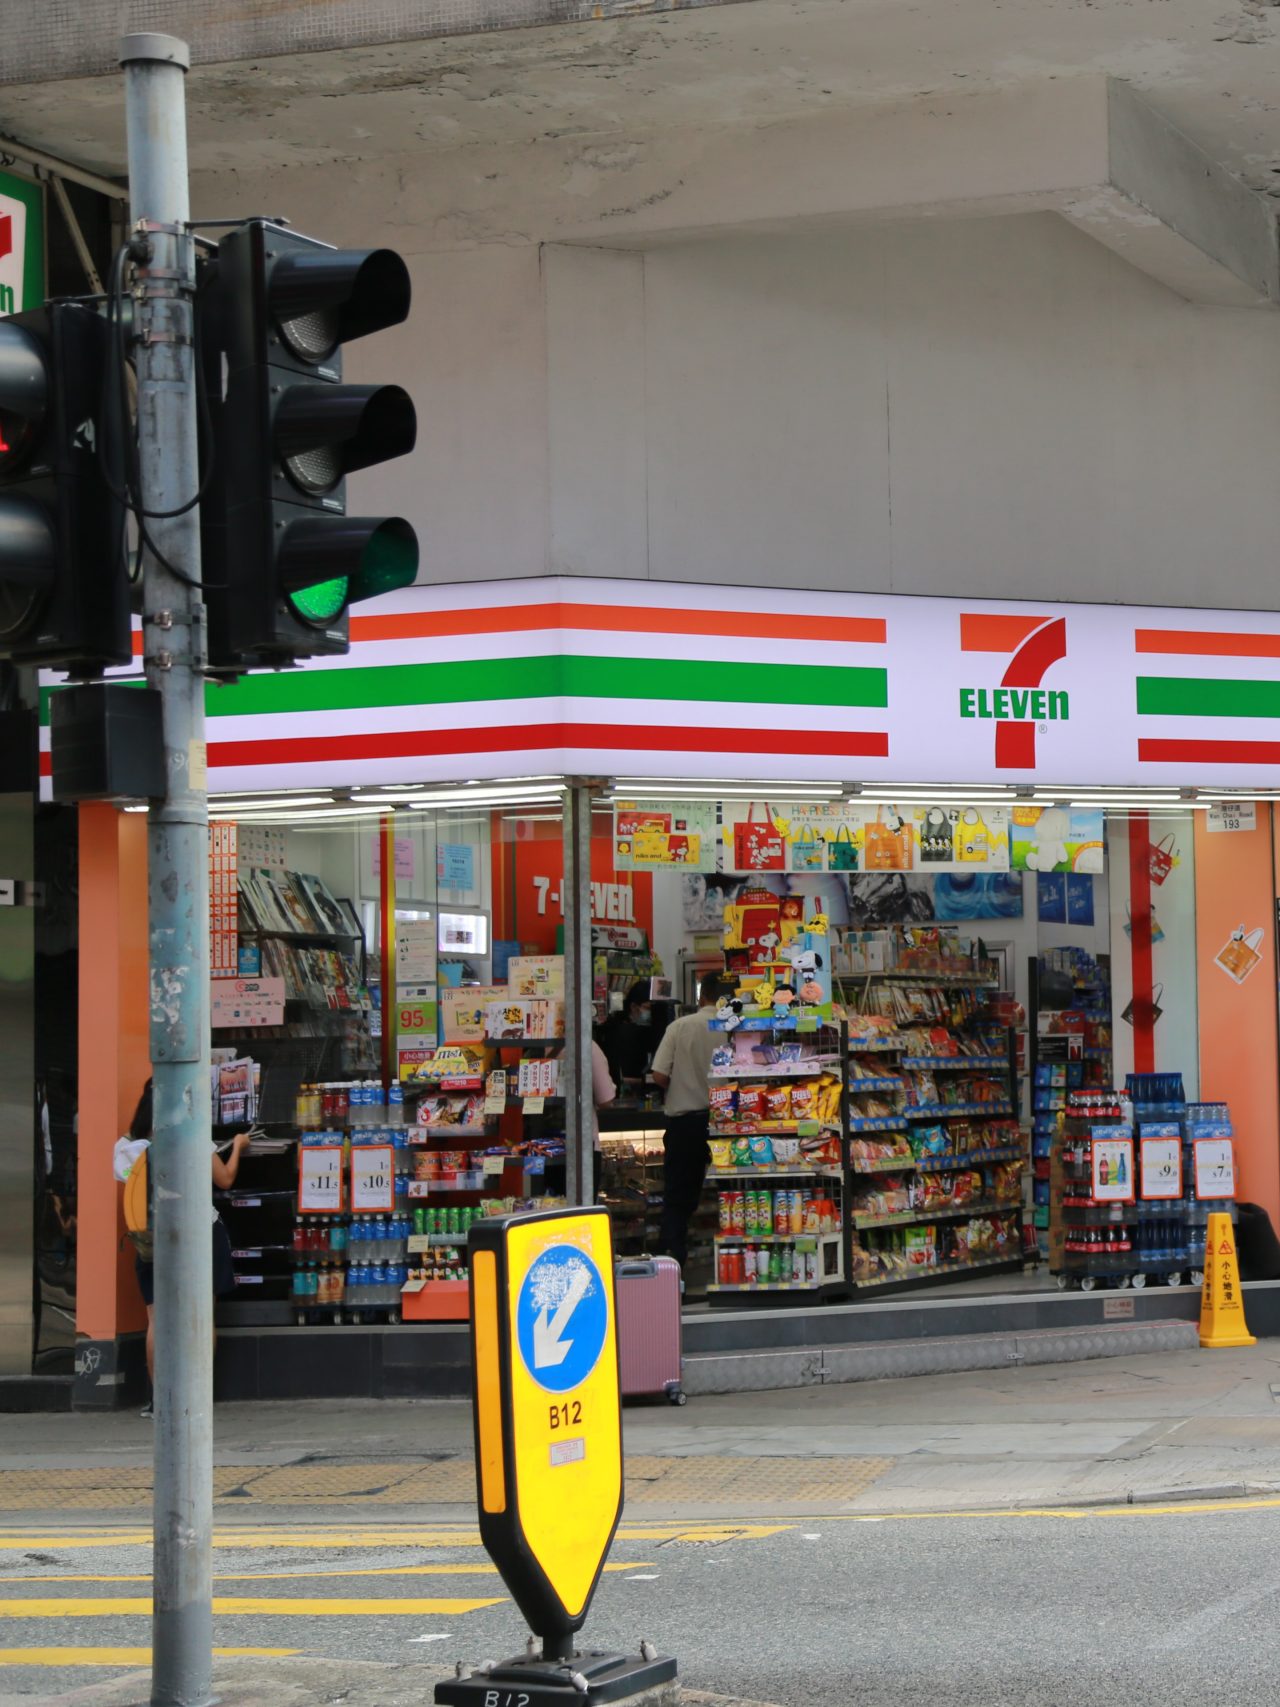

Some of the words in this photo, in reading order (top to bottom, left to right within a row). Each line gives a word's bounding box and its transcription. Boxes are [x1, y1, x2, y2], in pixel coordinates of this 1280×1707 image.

[959, 612, 1067, 770] 7
[1223, 819, 1240, 829] 193
[311, 1175, 338, 1190] $11.5
[363, 1175, 390, 1189] $10.5
[1222, 1261, 1233, 1301] 小心地滑
[549, 1400, 582, 1429] B12
[485, 1690, 530, 1707] B12
